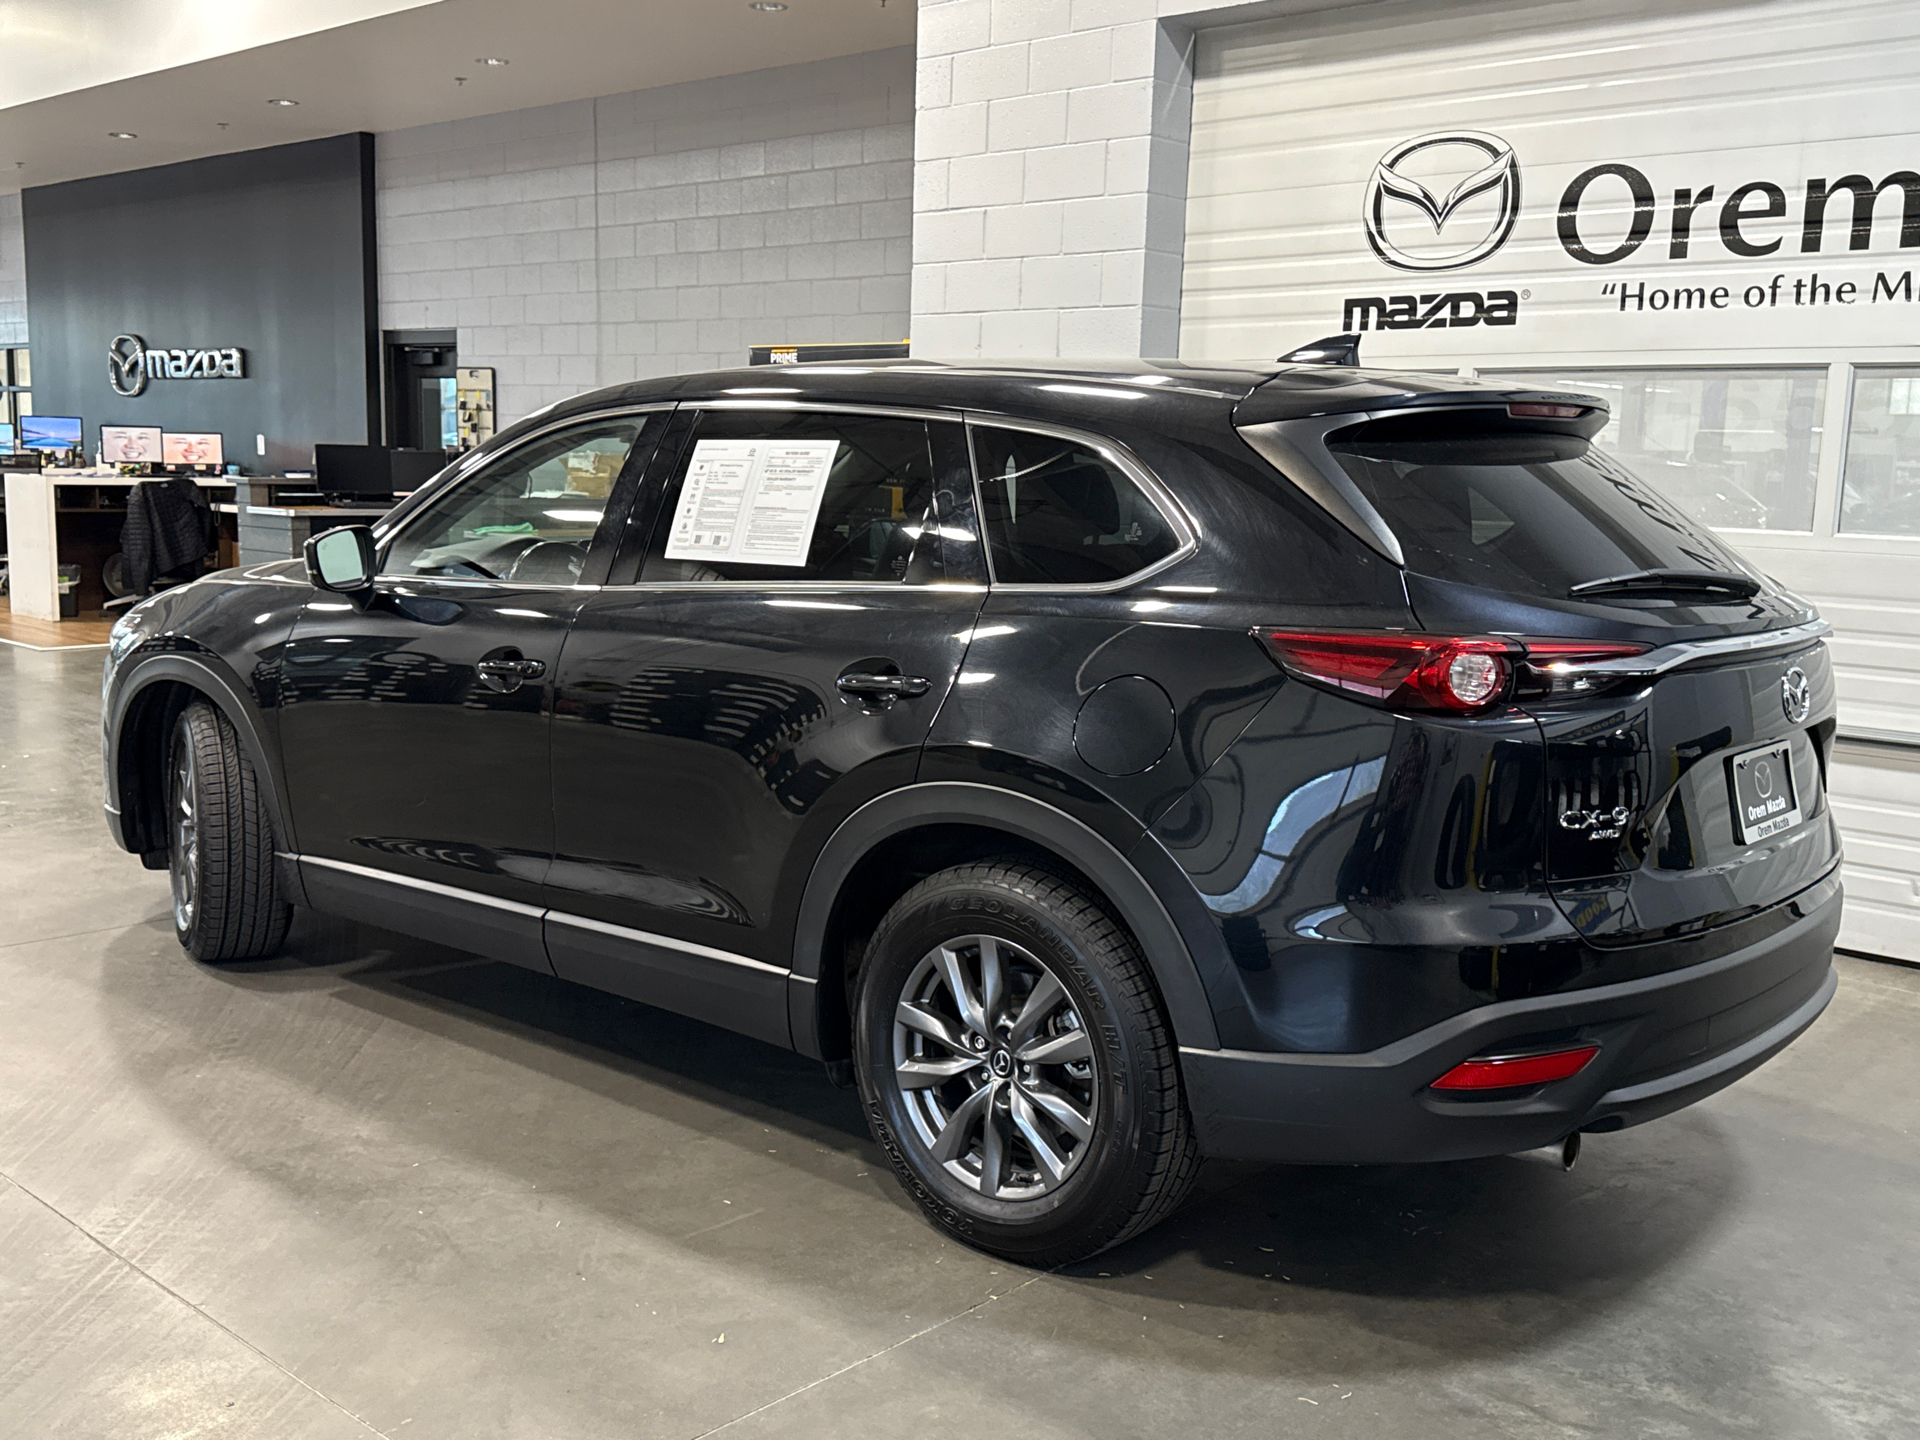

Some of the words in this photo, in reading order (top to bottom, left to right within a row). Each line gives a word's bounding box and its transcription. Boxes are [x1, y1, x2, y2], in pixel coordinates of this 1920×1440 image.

[1556, 163, 1920, 265] Orem
[1743, 274, 1785, 308] of
[1793, 273, 1857, 306] the
[1871, 270, 1920, 304] M
[770, 352, 798, 364] PRIME
[1560, 806, 1629, 829] CX-9
[1748, 804, 1767, 821] Orem
[1766, 795, 1787, 814] Mazda
[1757, 824, 1773, 838] Orem
[1772, 816, 1790, 831] Mazda
[950, 896, 1107, 1011] GEOLANDAR
